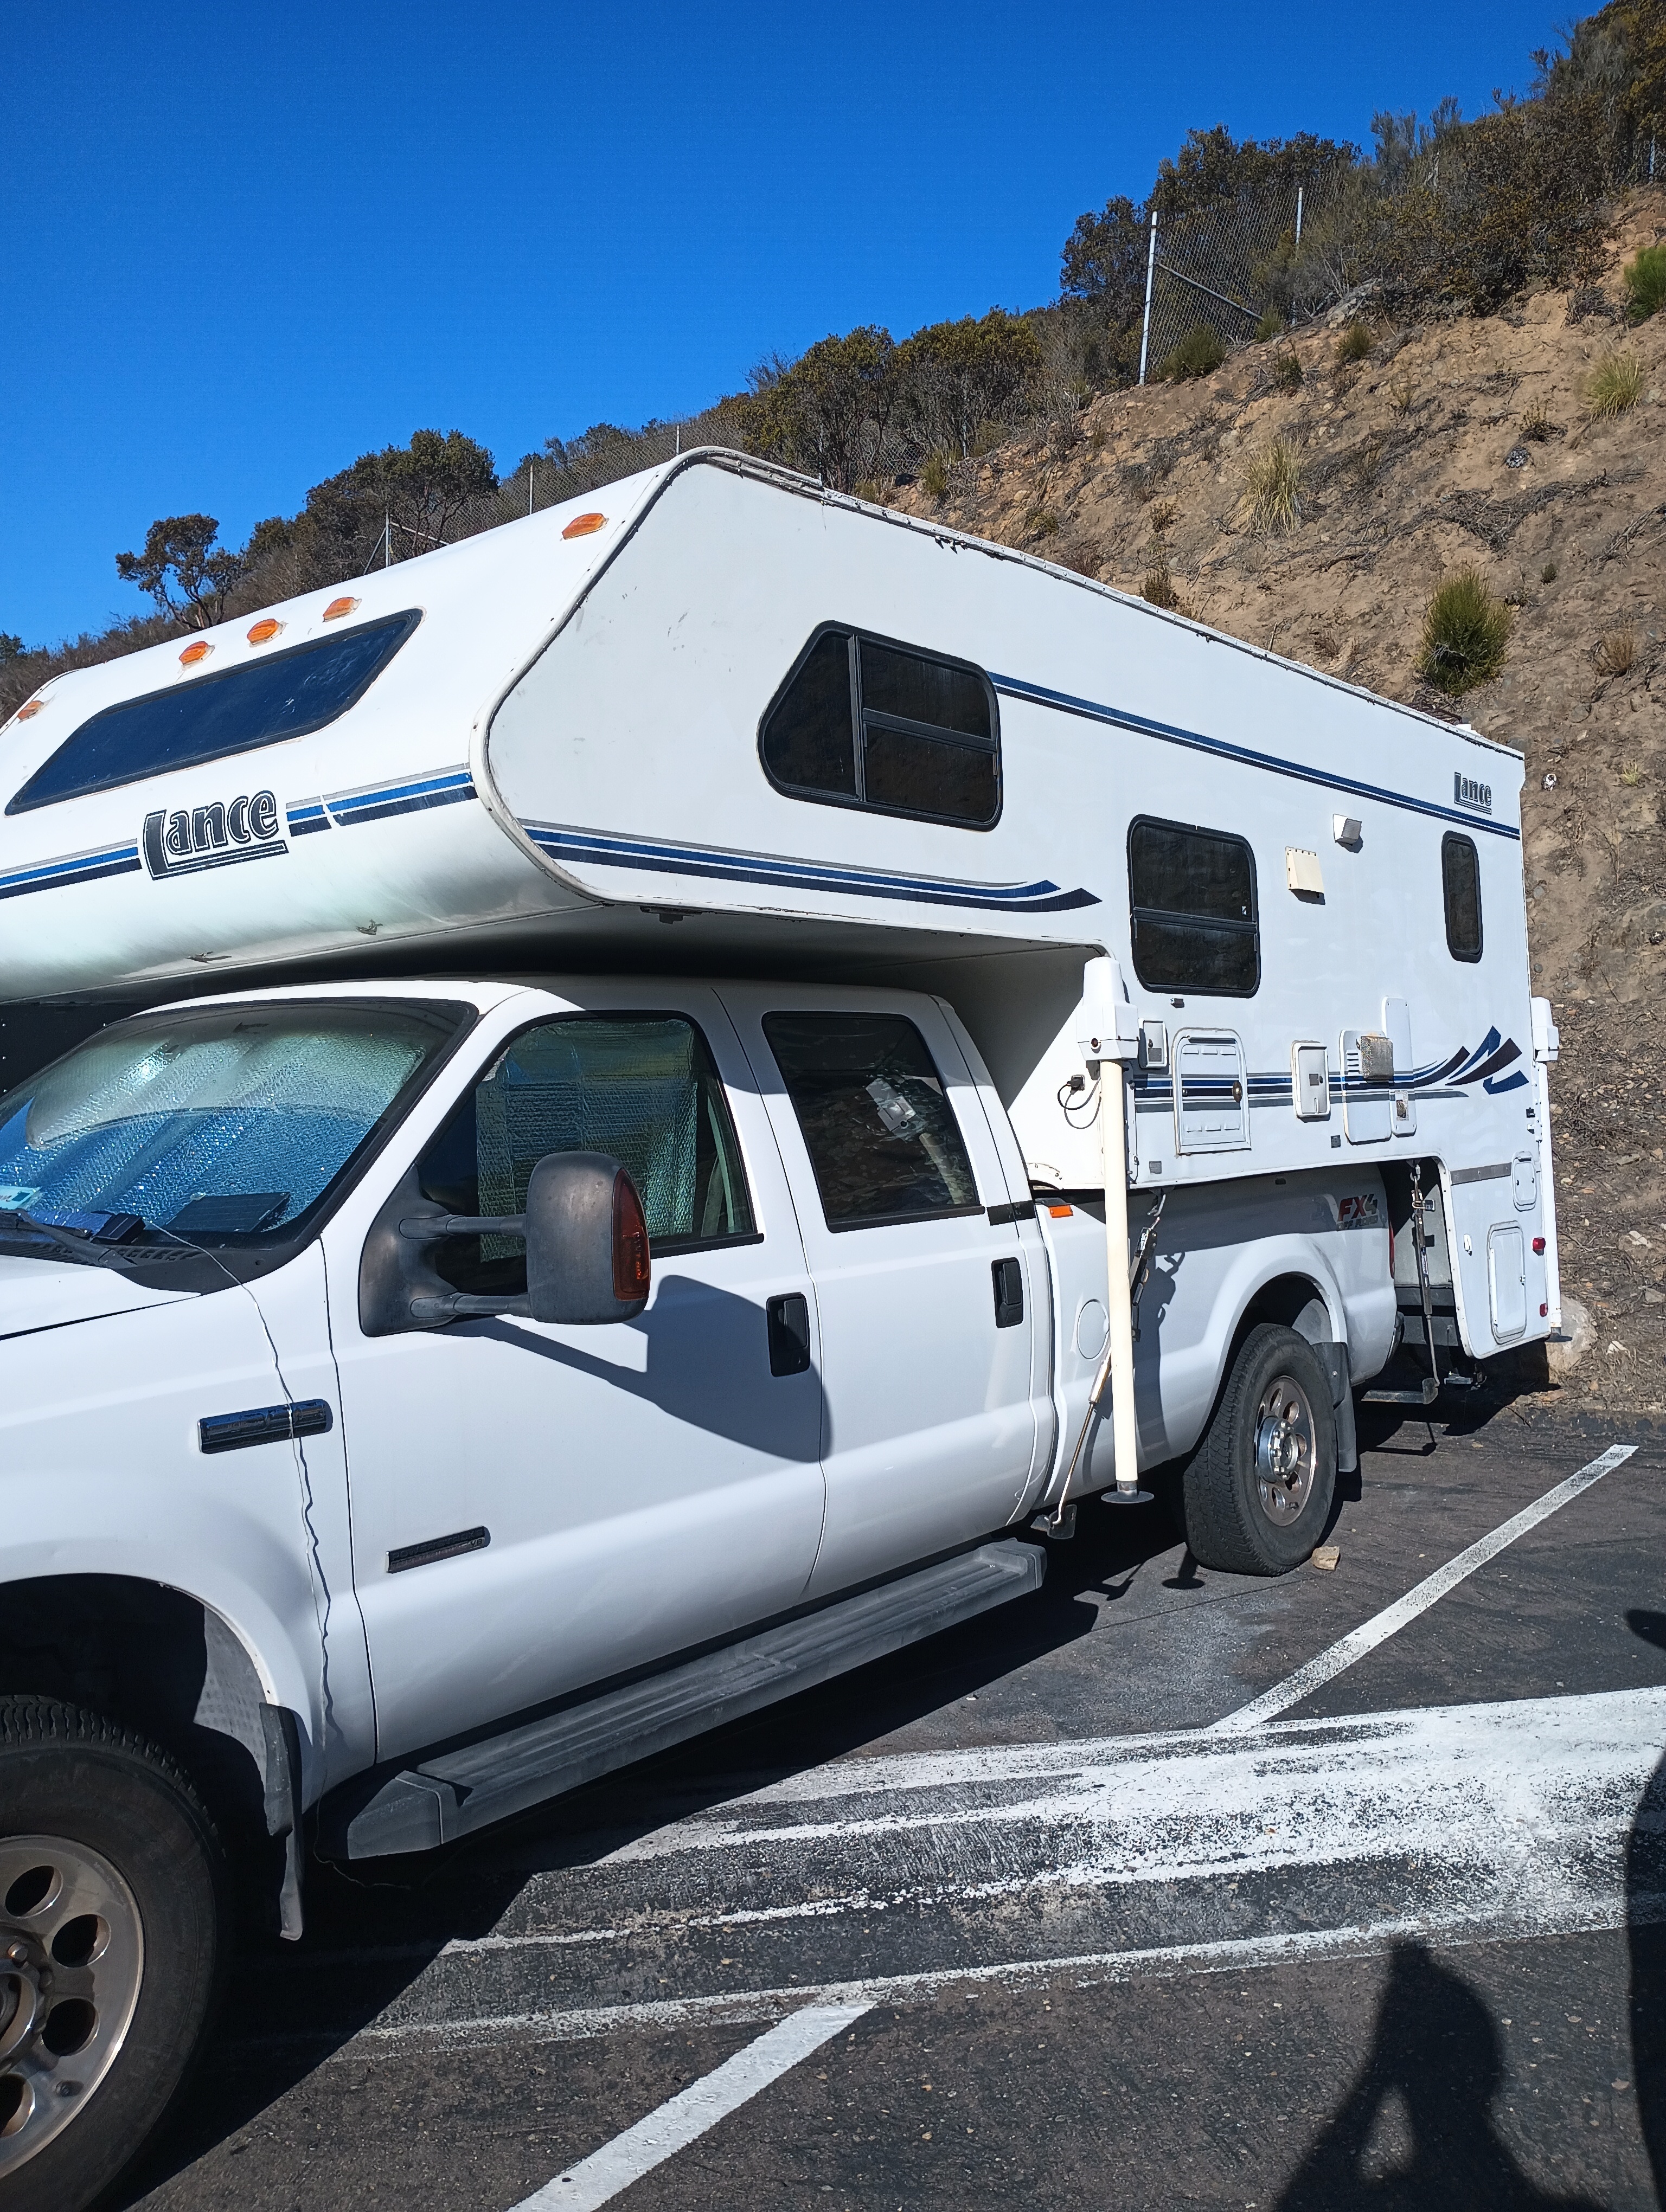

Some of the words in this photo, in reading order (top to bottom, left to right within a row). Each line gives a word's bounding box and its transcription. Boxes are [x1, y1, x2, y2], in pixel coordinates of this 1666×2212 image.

[1454, 771, 1492, 815] Lance
[143, 790, 290, 880] Lance
[1337, 1193, 1378, 1221] FX4
[1355, 1214, 1379, 1228] ROAD
